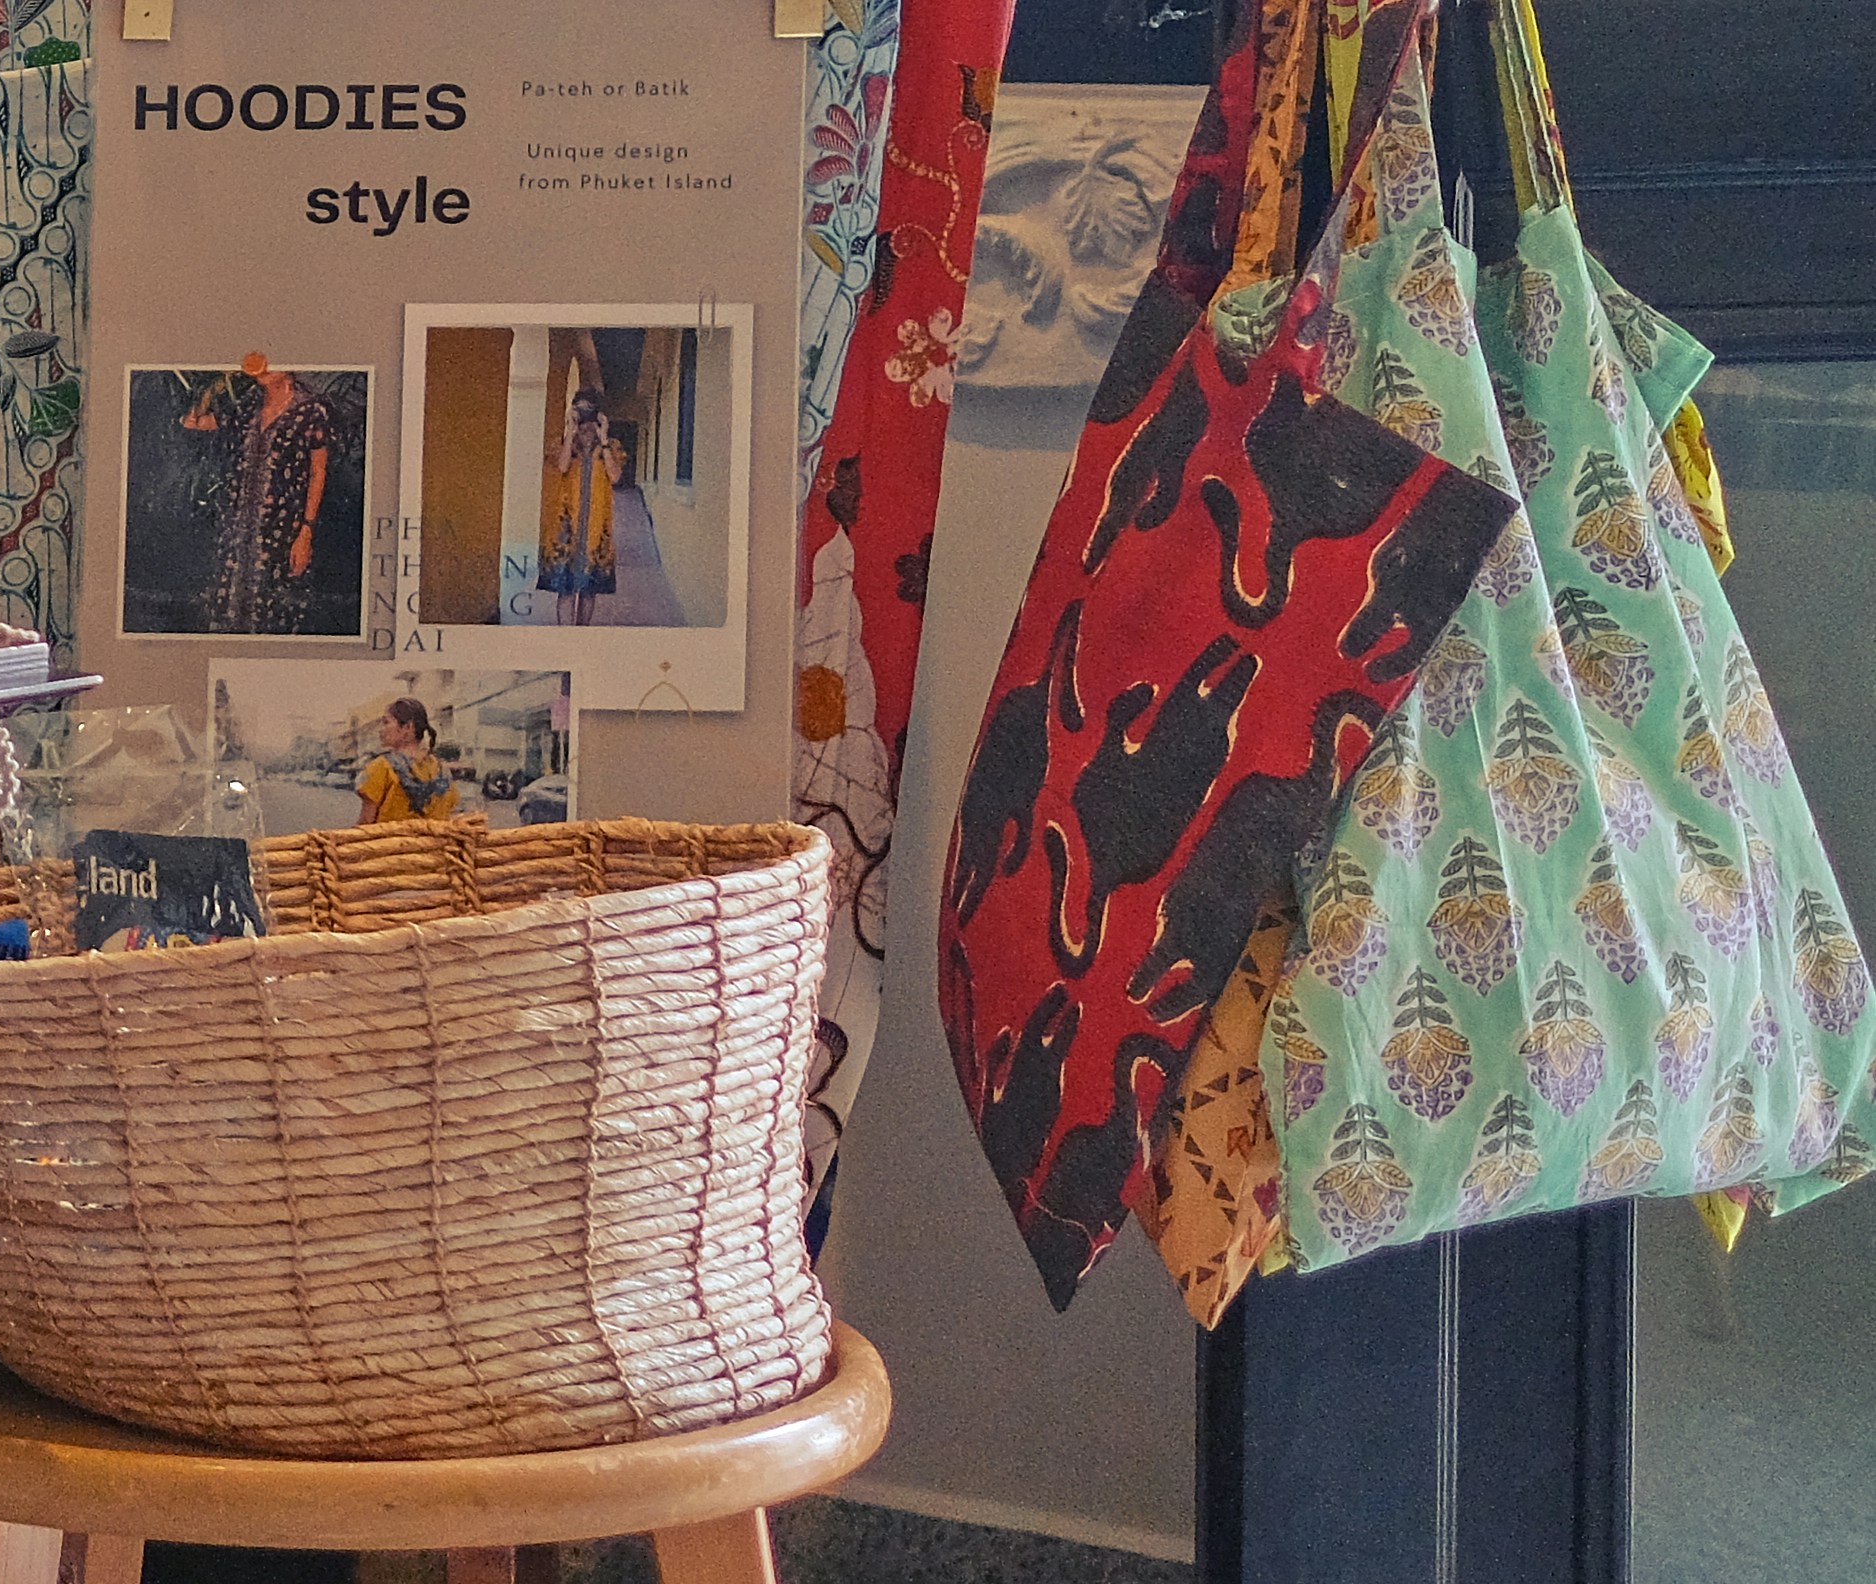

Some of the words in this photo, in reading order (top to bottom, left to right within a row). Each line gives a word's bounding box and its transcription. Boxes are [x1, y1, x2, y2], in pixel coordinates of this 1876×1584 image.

[521, 80, 593, 97] Pa-teh
[603, 83, 625, 97] or
[635, 79, 690, 97] Batik
[134, 83, 467, 131] HOODIES
[527, 143, 605, 163] Unique
[614, 142, 689, 163] design
[519, 173, 570, 190] from
[580, 173, 655, 190] Phuket
[666, 173, 733, 190] Island
[305, 175, 471, 237] style
[372, 627, 445, 653] DAI
